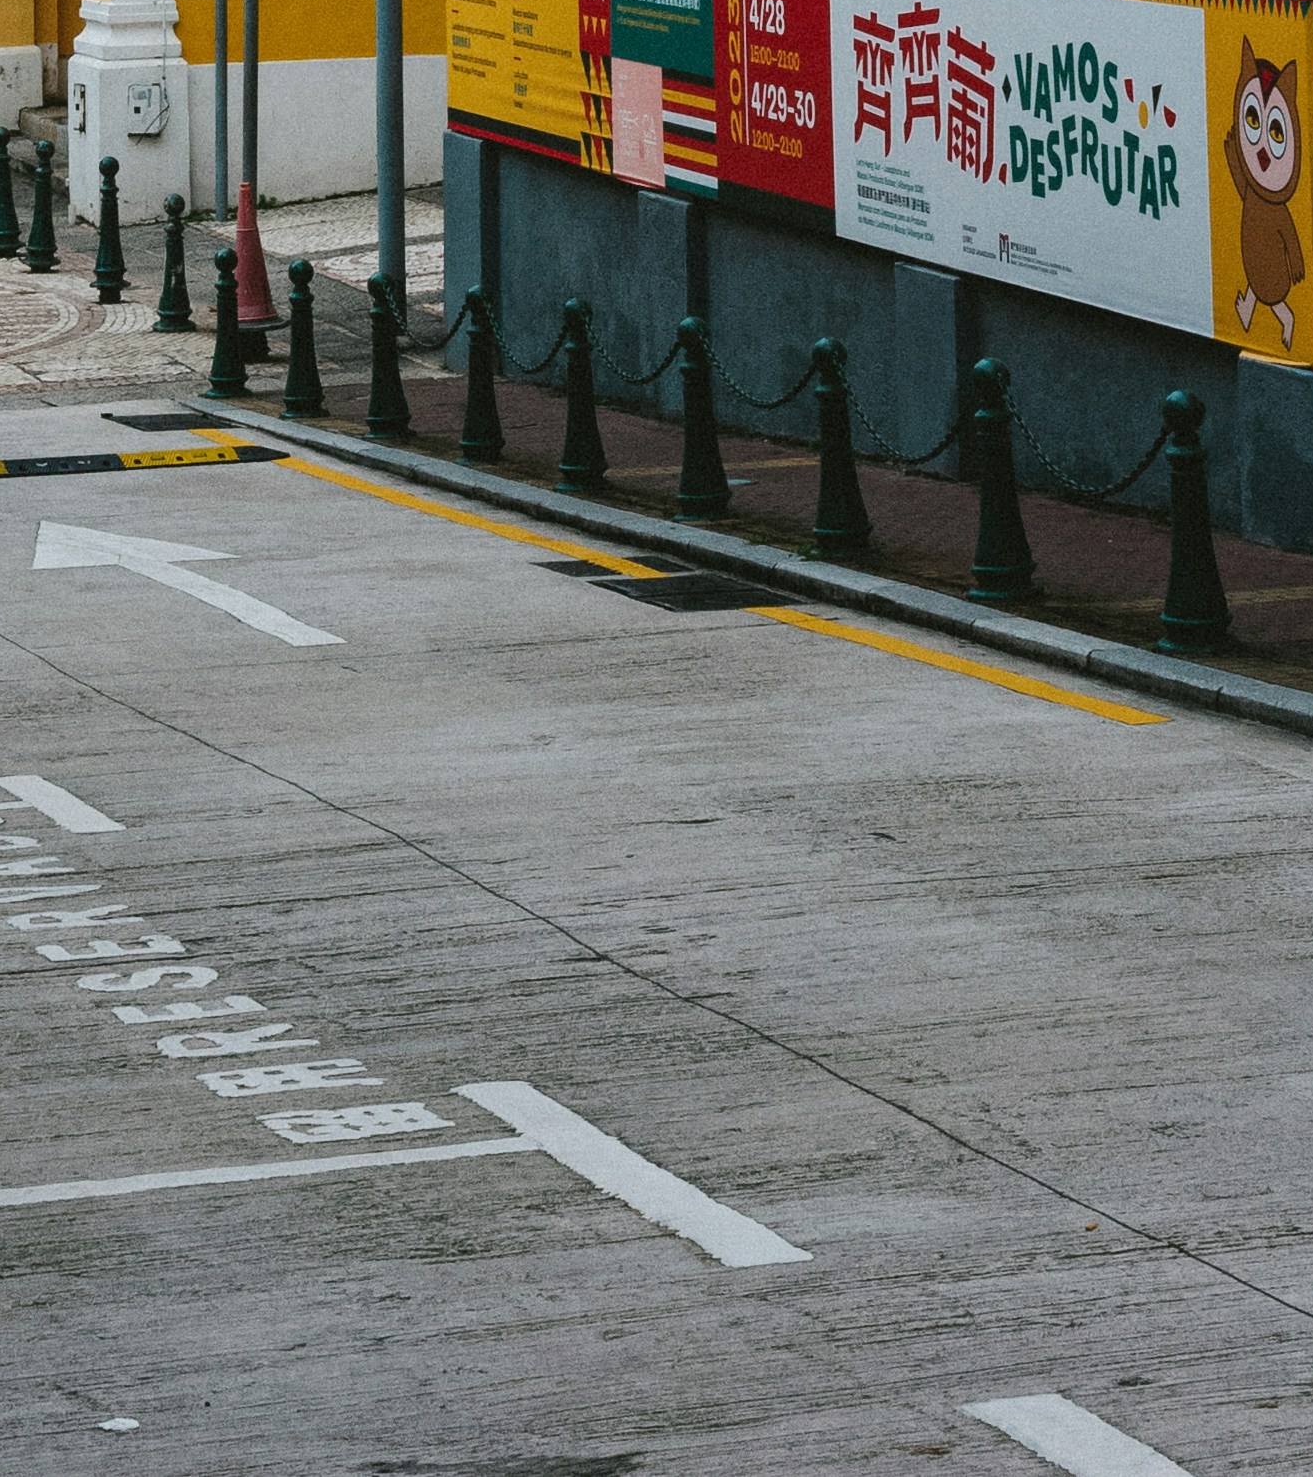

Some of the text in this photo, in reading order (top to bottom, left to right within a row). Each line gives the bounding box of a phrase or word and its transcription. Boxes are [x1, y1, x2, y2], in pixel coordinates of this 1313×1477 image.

[750, 81, 817, 130] 4/29-30
[1013, 41, 1119, 124] VAMOS
[1008, 114, 1181, 221] DESFRUTAR
